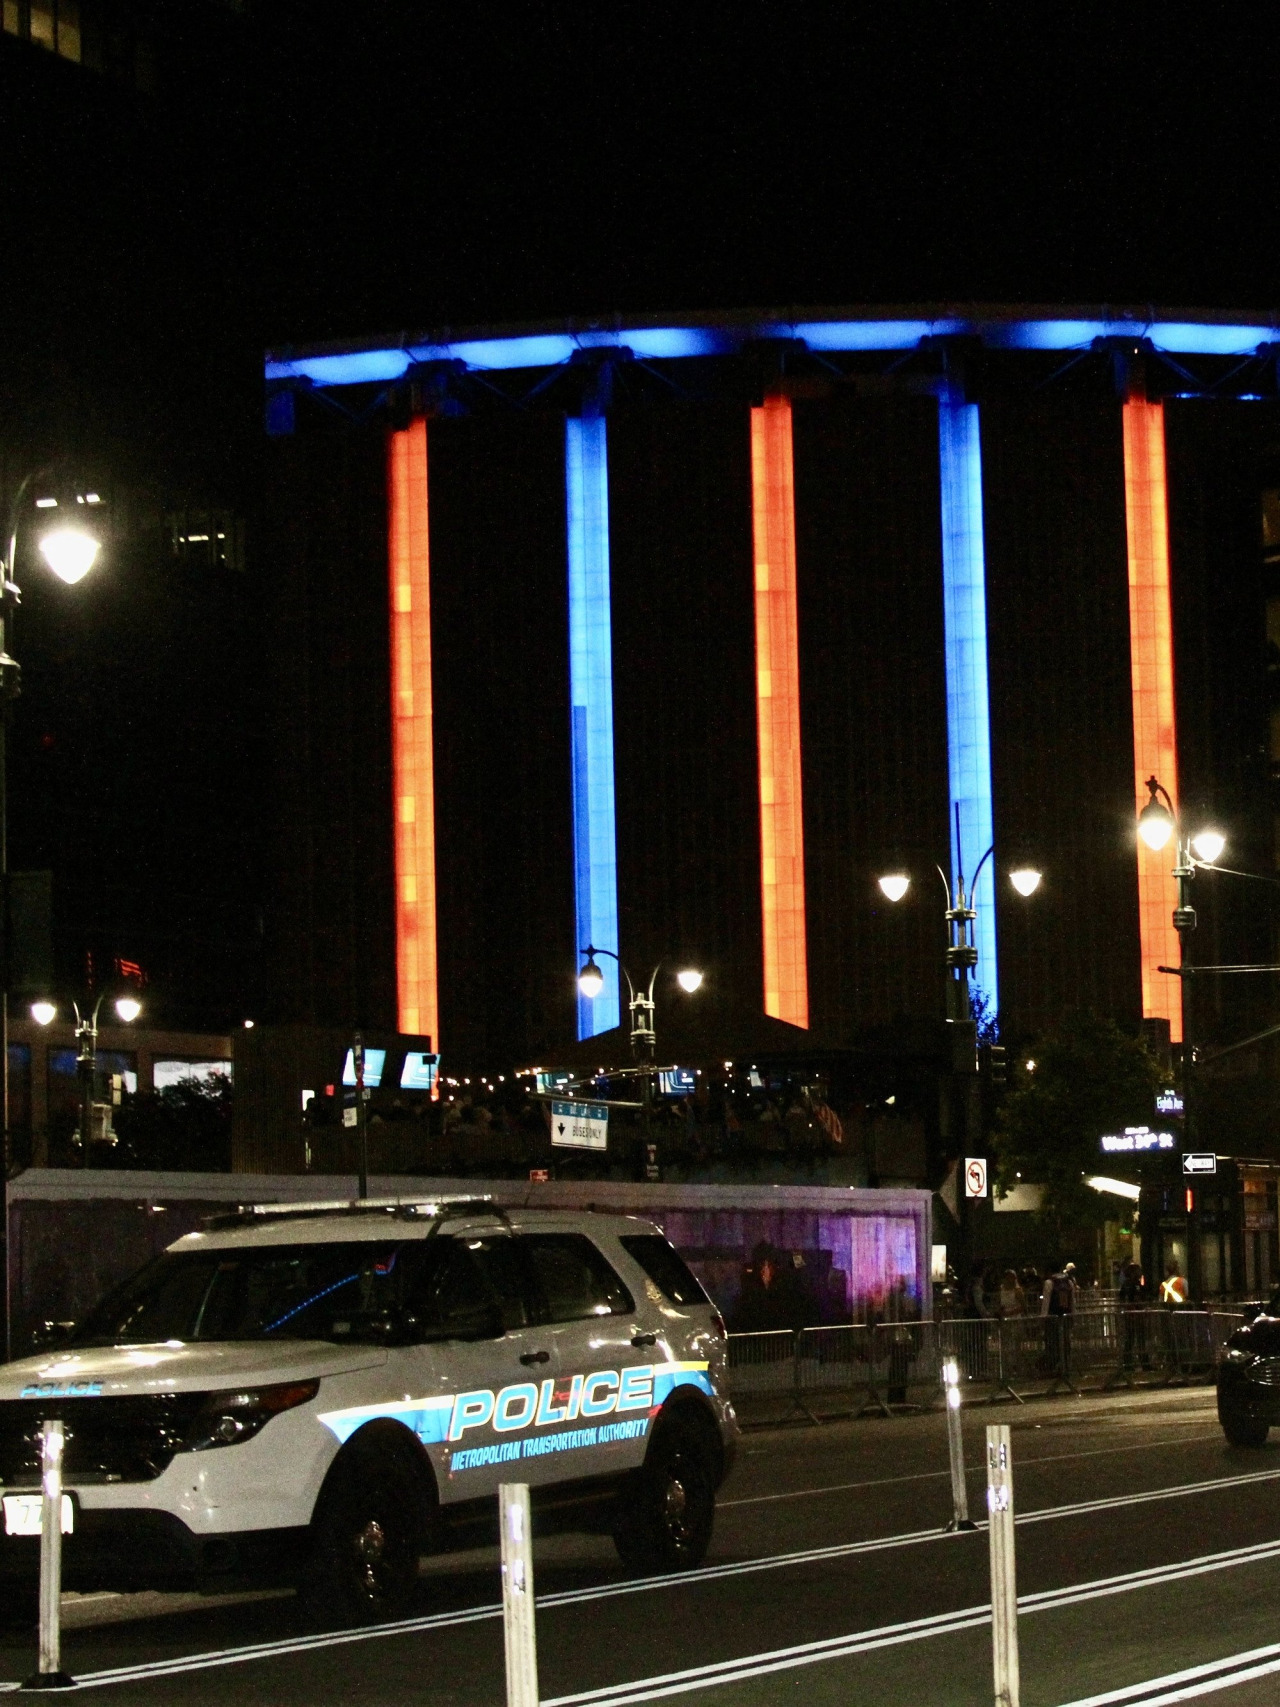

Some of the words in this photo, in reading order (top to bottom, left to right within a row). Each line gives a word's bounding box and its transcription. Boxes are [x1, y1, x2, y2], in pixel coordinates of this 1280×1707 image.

[21, 1381, 105, 1398] POLICE
[449, 1364, 654, 1441] POLICE
[451, 1441, 522, 1471] METROPOLITAN
[522, 1427, 597, 1458] TRANSPORTATION
[598, 1418, 649, 1444] AUTHORITY
